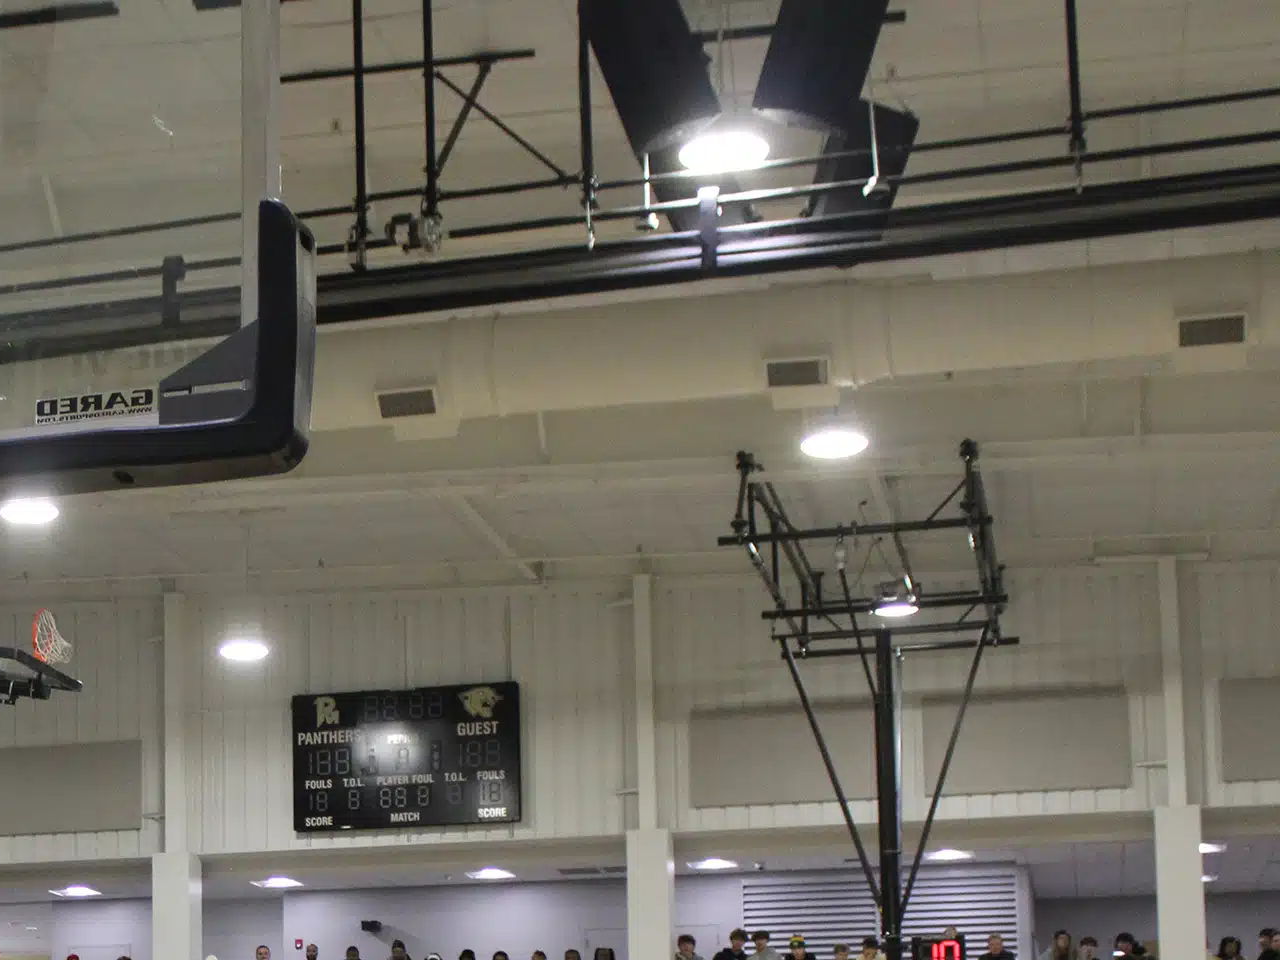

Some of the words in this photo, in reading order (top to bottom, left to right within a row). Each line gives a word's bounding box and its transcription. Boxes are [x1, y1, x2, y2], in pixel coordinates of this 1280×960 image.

[297, 729, 361, 745] PANTHERS
[457, 721, 499, 736] GUEST
[305, 779, 332, 790] FOULS
[377, 775, 408, 785] PLAYER
[412, 773, 434, 784] FOUL
[477, 770, 505, 780] FOULS
[305, 816, 333, 827] SCORE
[390, 812, 420, 822] MATCH
[478, 807, 507, 818] SCORE
